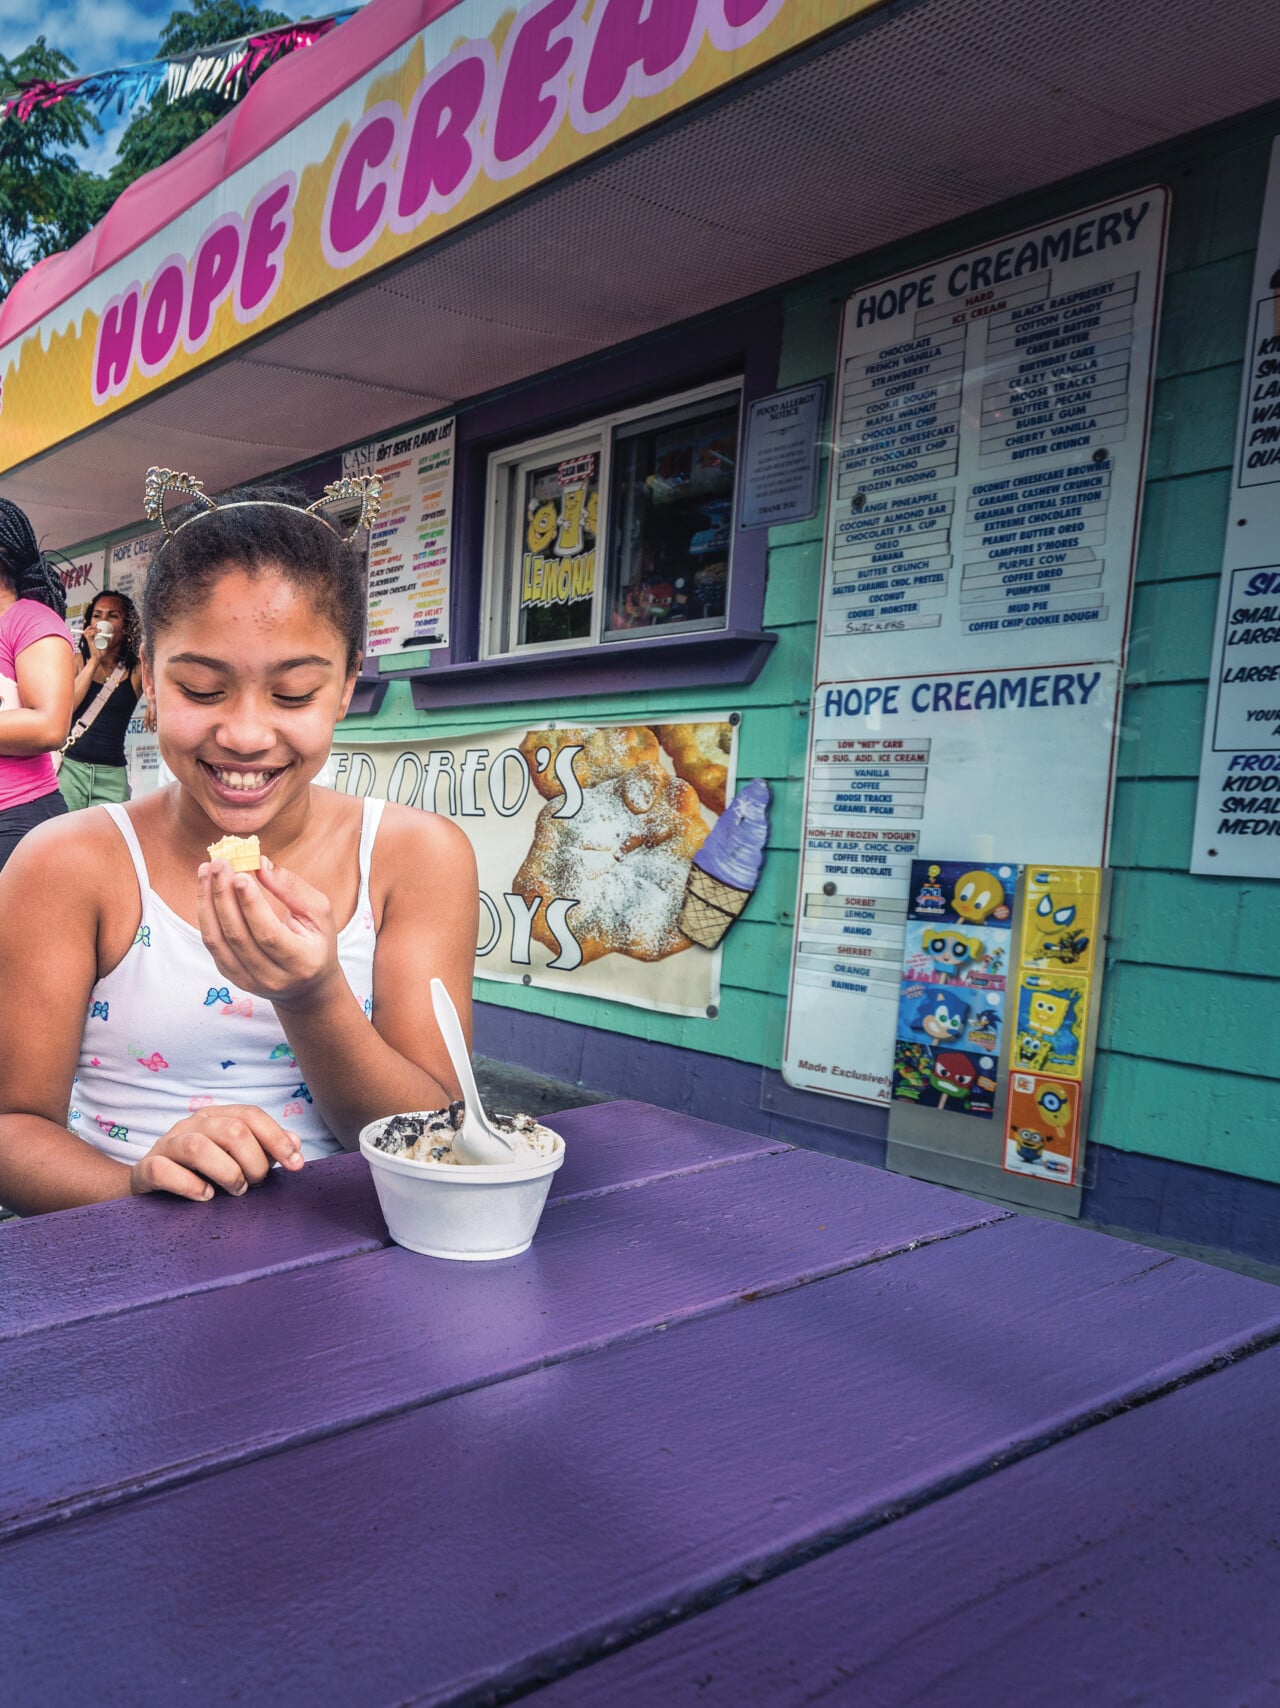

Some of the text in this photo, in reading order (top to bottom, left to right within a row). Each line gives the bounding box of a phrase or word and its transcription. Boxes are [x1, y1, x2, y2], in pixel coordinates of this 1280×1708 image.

[95, 0, 767, 396] HOPE CREA
[856, 201, 1150, 328] HOPE CREAMERY
[965, 290, 994, 307] HARD
[1011, 282, 1116, 320] BLACK RASPBERRY
[952, 301, 1007, 325] ICE CREAM
[1015, 301, 1103, 333] COTTON CANDY
[1015, 316, 1100, 347] BROWNIE BATTER
[879, 338, 931, 359] CHOCOLATE
[1026, 332, 1090, 356] CAKE BATTER
[866, 348, 941, 374] FRENCH VANILLA
[1019, 346, 1096, 373] BIRTHDAY CAKE
[872, 365, 930, 387] STRAWBERRY
[1009, 359, 1097, 389] CRAZY VANILLA
[885, 382, 915, 397] COFFEE
[1009, 374, 1096, 404] MOOSE TRACKS
[756, 393, 816, 417] FOOD ALLERGY
[866, 389, 937, 414] COOKIE DOUGH
[1013, 390, 1092, 416] BUTTER PECAN
[769, 407, 800, 421] NOTICE
[866, 403, 937, 427] MAPLE WALNUT
[1016, 405, 1086, 429] BUBBLE GUM
[393, 437, 413, 457] SERVE
[413, 428, 438, 450] FLAVOR
[438, 419, 454, 440] LIST
[862, 416, 937, 441] CHOCOLATE CHIP
[1005, 419, 1096, 447] CHERRY VANILLA
[842, 425, 955, 458] STRAWBERRY CHEESECAKE
[1012, 435, 1090, 460] BUTTER CRUNCH
[343, 442, 376, 470] CASH
[846, 439, 947, 470] MINT CHOCOLATE CHIP
[873, 461, 918, 476] PISTACHIO
[973, 460, 1111, 495] COCONUT CHEESECAKE BROWNIE
[858, 470, 936, 493] FROZEN PUDDING
[979, 476, 1103, 507] CARAMEL CASHEW CRUNCH
[892, 492, 938, 507] PINEAPPLE
[974, 491, 1101, 521] GRAHAM CENTRAL STATION
[840, 505, 946, 531] COCONUT ALMOND BAR
[984, 506, 1082, 532] EXTREME CHOCOLATE
[846, 520, 937, 543] CHOCOLATE CUP
[982, 522, 1085, 546] PEANUT BUTTER OREO
[875, 540, 900, 551] OREO
[989, 544, 1034, 559] CAMPFIRE
[872, 551, 904, 563] BANANA
[998, 553, 1067, 571] PURPLE COW
[858, 561, 929, 578] BUTTER CRUNCH
[1002, 568, 1063, 584] COFFEE OREO
[832, 573, 944, 595] SALTED CARAMEL PRETZEL
[1006, 583, 1050, 597] PUMPKIN
[869, 591, 905, 603] COCONUT
[1008, 601, 1048, 613] MUD PIE
[847, 603, 918, 619] COOKIE MONSTER
[969, 610, 1099, 631] COFFEE CHIP COOKIE DOUGH
[825, 672, 1100, 717] HOPE CREAMERY
[838, 740, 854, 749] LOW
[817, 754, 829, 762] NO
[855, 753, 875, 762] ADD.
[878, 753, 891, 762] ICE
[894, 753, 925, 762] CREAM
[854, 769, 890, 778] VANILLA
[851, 781, 880, 790] COFFEE
[836, 793, 893, 803] MOOSE TRACKS
[833, 804, 894, 815] CARAMEL PECAN
[846, 830, 879, 839] FROZEN
[808, 840, 833, 849] BLACK
[895, 844, 915, 853] CHIP
[833, 853, 887, 864] COFFEE TOFFEE
[825, 865, 892, 876] TRIPLE CHOCOLATE
[845, 897, 876, 907] SORBET
[844, 910, 875, 920] LEMON
[843, 926, 872, 936] MANGO
[837, 946, 872, 956] SHERBET
[834, 964, 871, 977] ORANGE
[831, 980, 868, 993] RAINBOW
[798, 1059, 893, 1087] Made Exclusively
